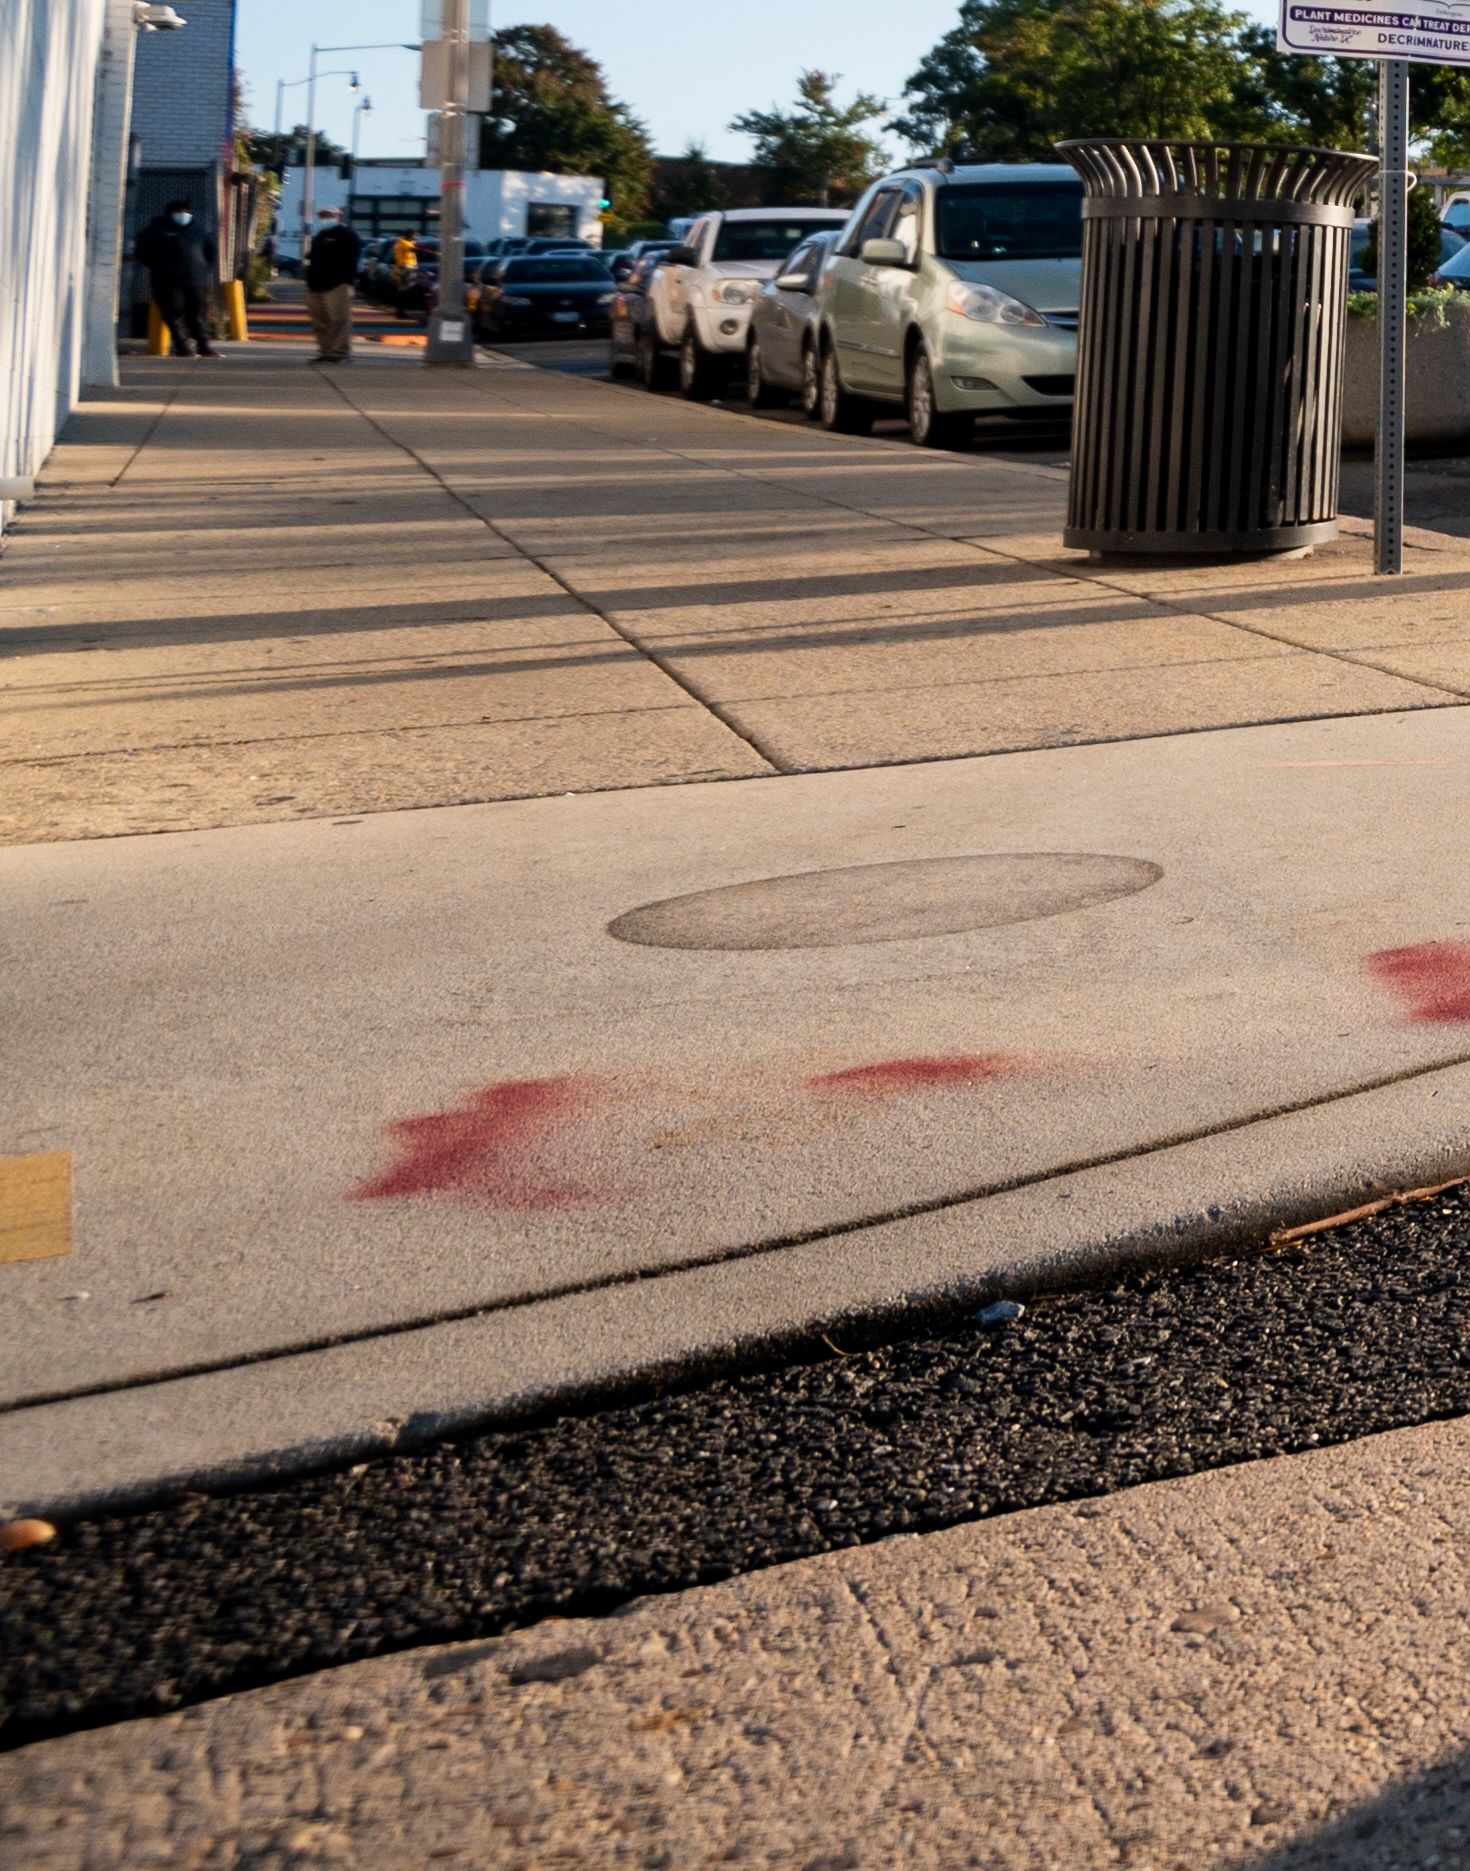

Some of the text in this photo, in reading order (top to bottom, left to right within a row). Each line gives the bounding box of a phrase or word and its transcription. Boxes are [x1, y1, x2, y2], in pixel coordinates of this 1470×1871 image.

[1294, 8, 1332, 22] PLANT
[1333, 12, 1399, 27] MEDICINES
[1401, 15, 1422, 28] CAN
[1423, 18, 1450, 32] TREAT
